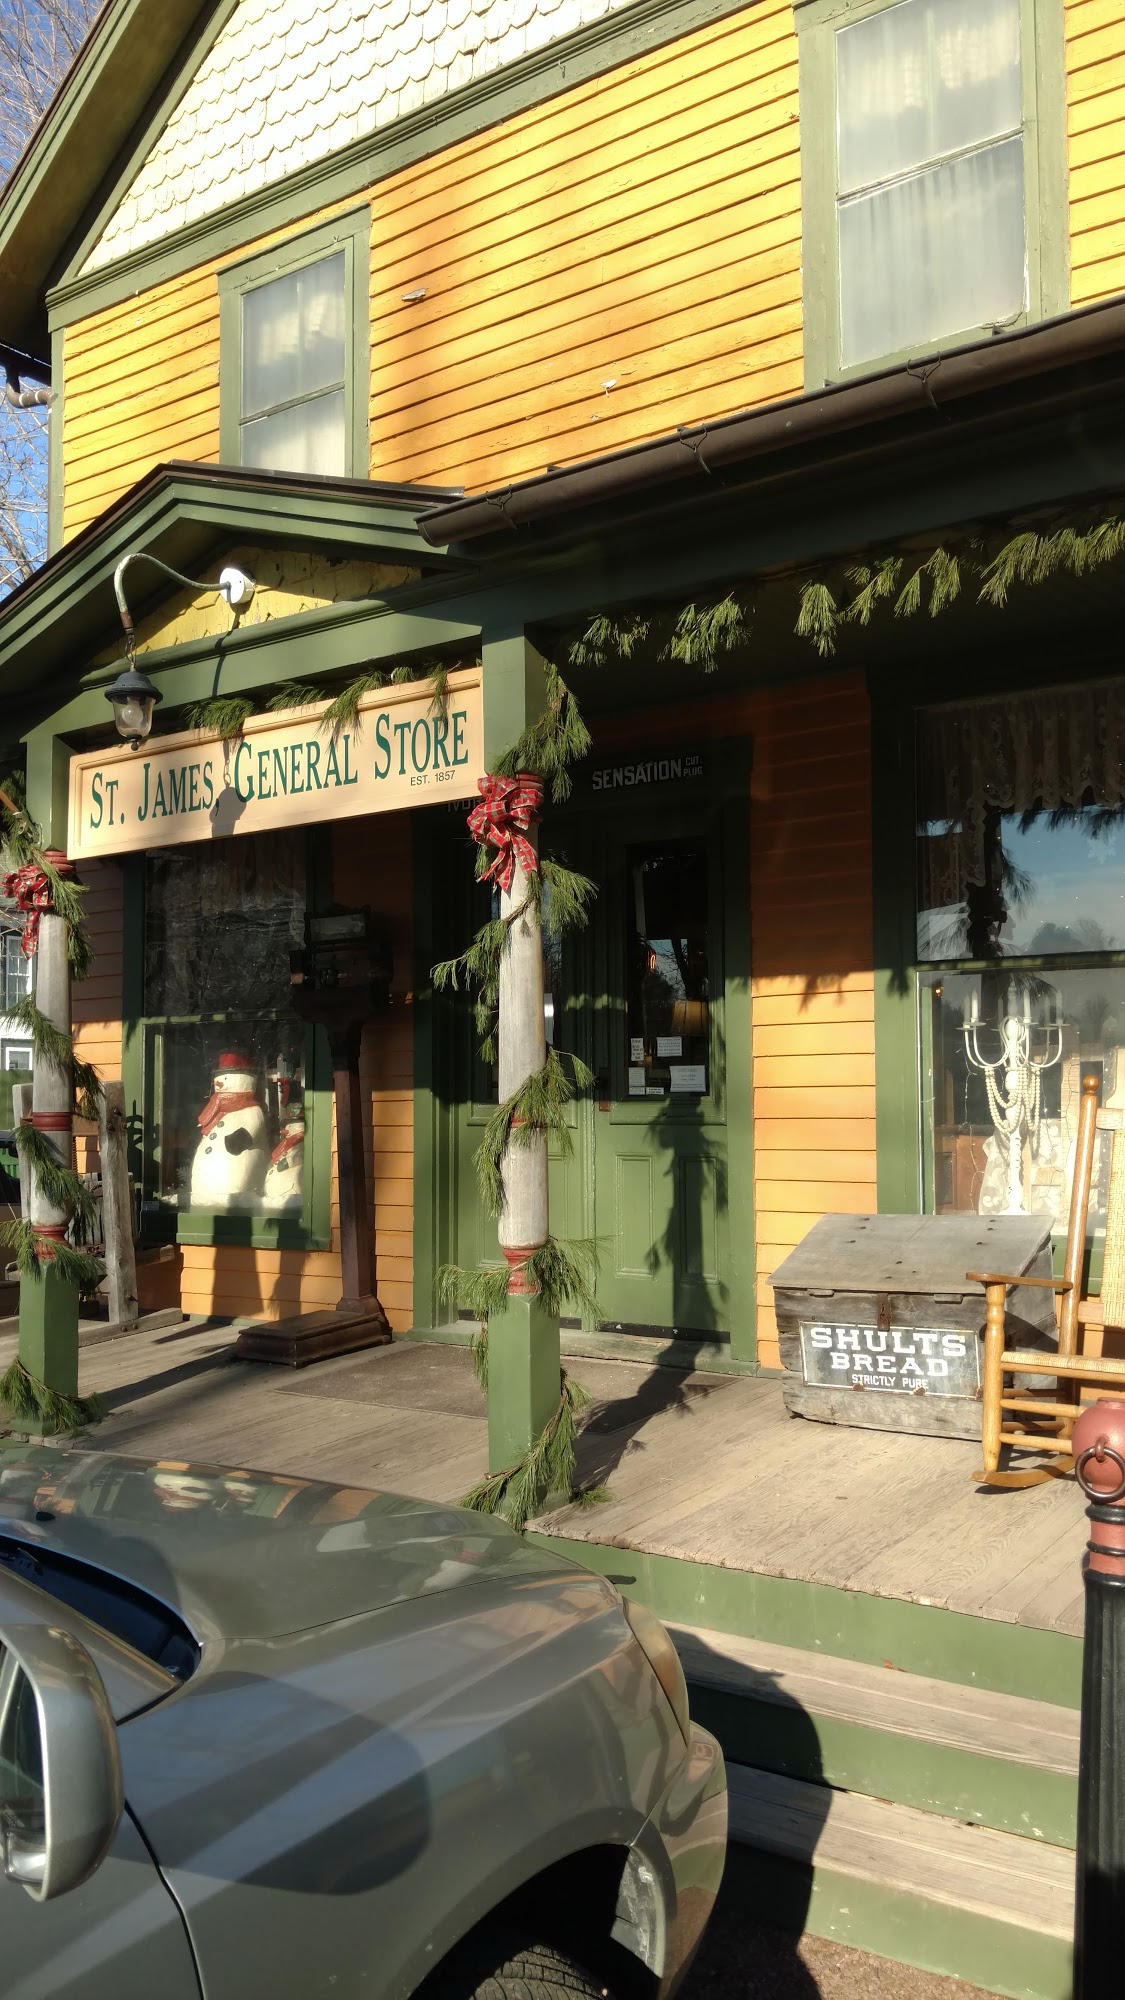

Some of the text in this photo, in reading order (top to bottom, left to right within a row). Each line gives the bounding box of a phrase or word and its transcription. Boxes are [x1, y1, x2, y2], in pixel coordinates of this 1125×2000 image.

[90, 772, 125, 829] ST.
[233, 734, 358, 803] GENERAL
[374, 710, 469, 780] STORE
[685, 755, 700, 766] CUT
[410, 769, 456, 786] EST. 1857
[592, 758, 682, 790] SENSATION
[683, 766, 703, 777] PLUG
[810, 1327, 967, 1357] SHULTS
[830, 1352, 949, 1377] BREAD
[851, 1373, 928, 1390] STRICTLY PURE
